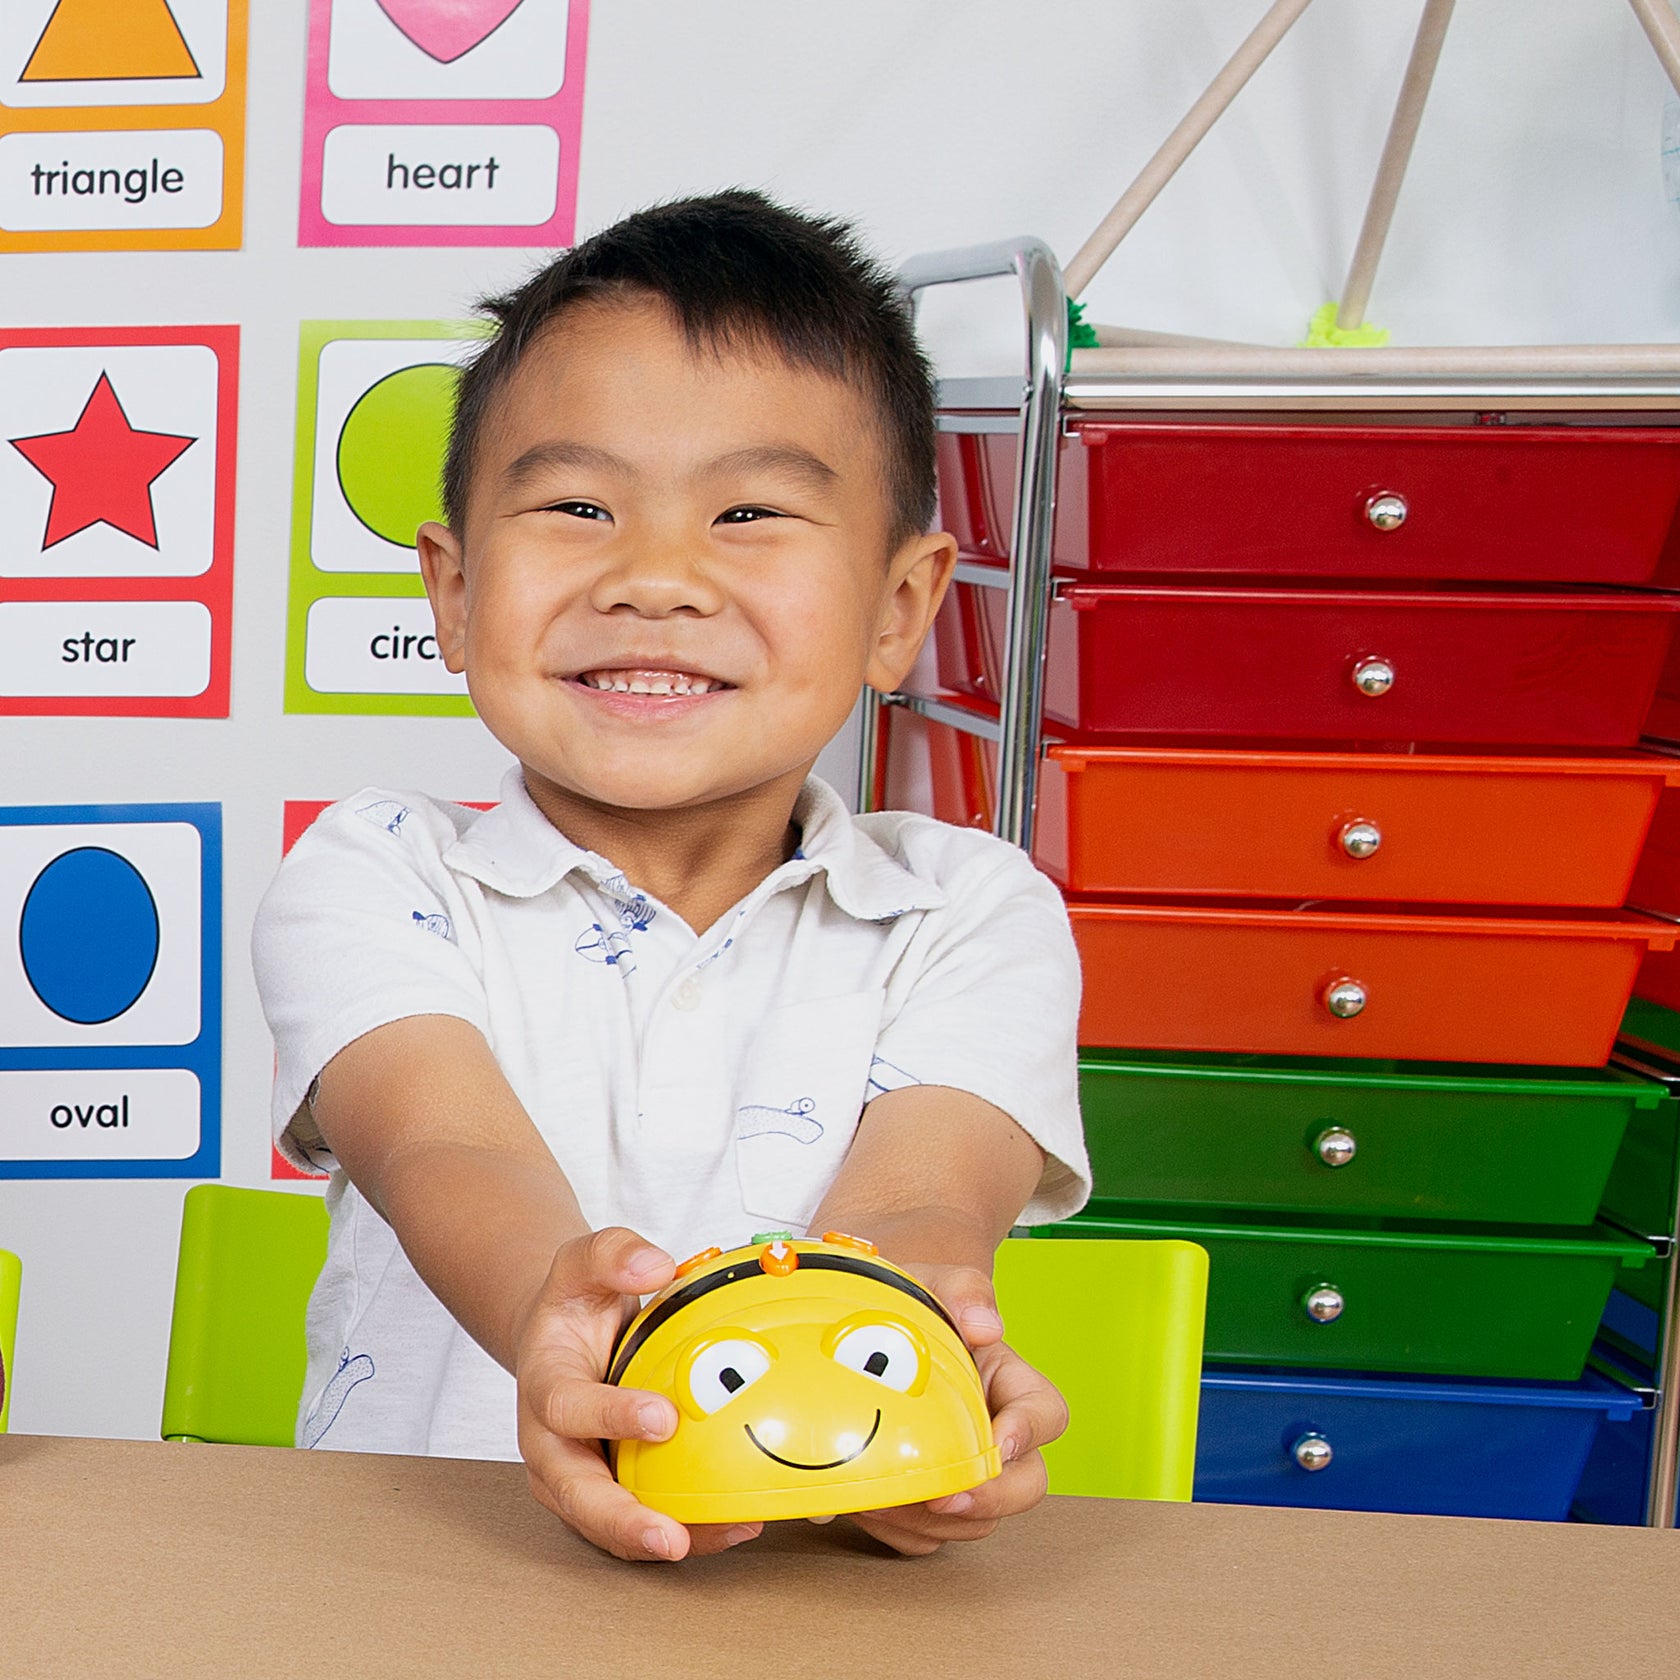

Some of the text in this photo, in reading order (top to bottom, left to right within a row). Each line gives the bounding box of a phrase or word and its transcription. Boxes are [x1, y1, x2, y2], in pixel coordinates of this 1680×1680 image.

[31, 158, 184, 204] triangle
[387, 153, 500, 190] heart
[61, 631, 136, 663] star
[370, 624, 443, 660] circ
[50, 1094, 129, 1129] oval
